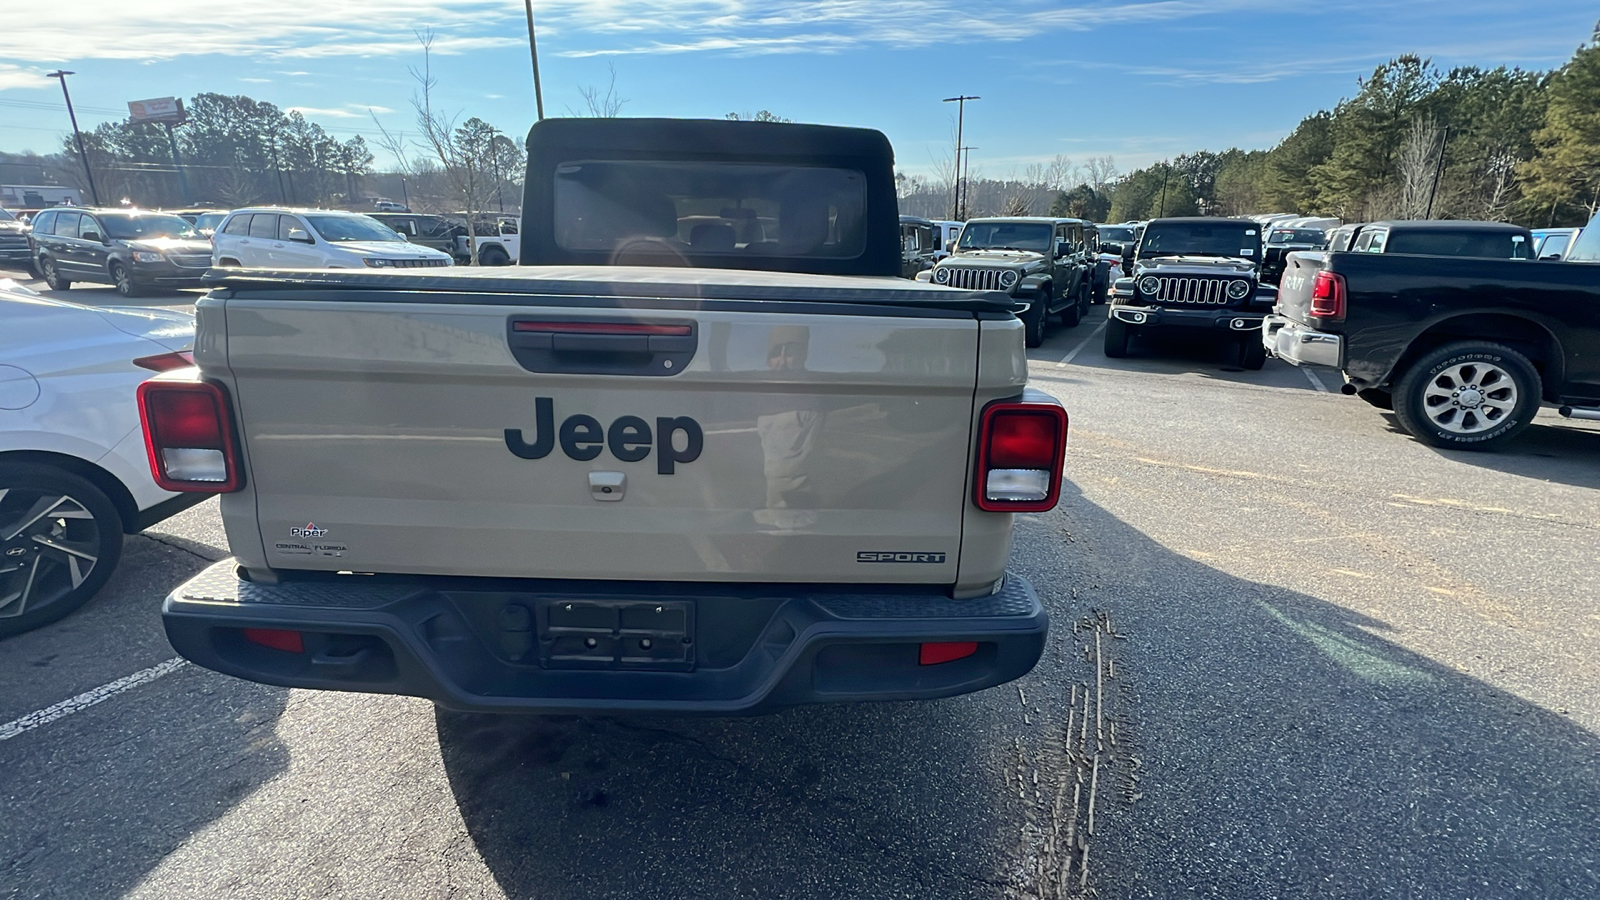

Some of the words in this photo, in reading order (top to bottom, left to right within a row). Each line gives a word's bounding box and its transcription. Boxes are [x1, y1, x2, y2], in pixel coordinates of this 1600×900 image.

[1285, 275, 1305, 291] RAM
[504, 396, 704, 475] Jeep
[290, 527, 326, 538] Piper
[857, 552, 946, 562] SPORT
